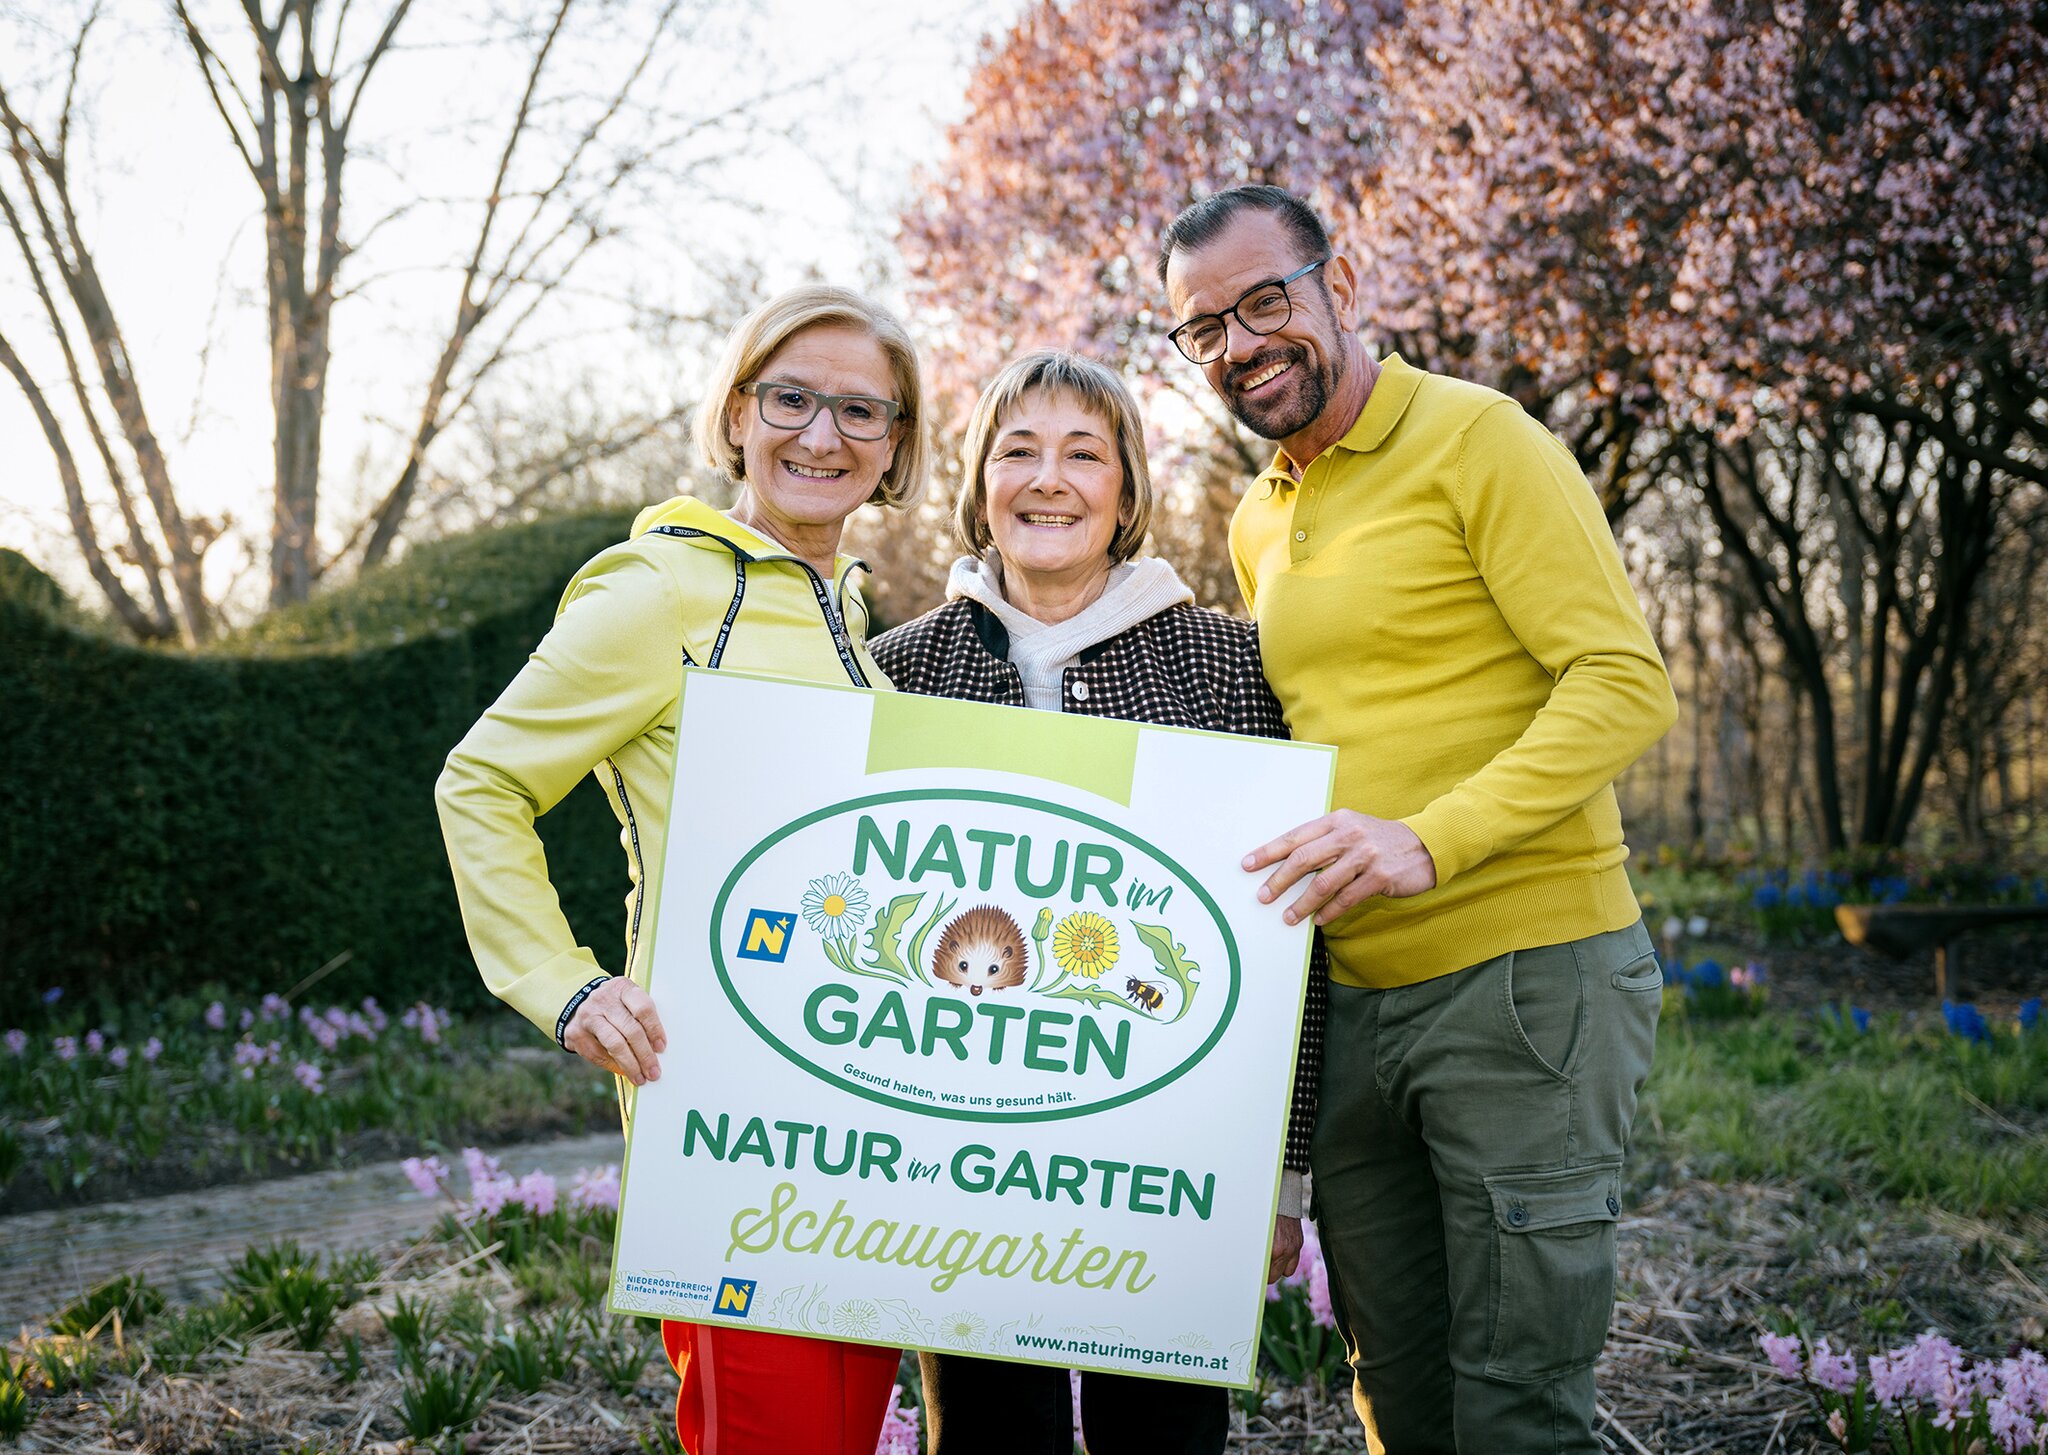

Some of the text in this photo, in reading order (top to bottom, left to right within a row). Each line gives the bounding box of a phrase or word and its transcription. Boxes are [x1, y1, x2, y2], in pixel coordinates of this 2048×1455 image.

[852, 815, 1174, 915] NATUR im
[803, 983, 1131, 1080] GARTEN
[843, 1063, 1077, 1108] Gesund halten, was uns gesund hält.
[682, 1108, 1216, 1221] NATUR im GARTEN
[725, 1182, 1157, 1294] Schaugarten
[625, 1283, 712, 1302] Einfach erfrischend.
[626, 1275, 713, 1293] NIEDERÖSTERREICH
[1015, 1333, 1230, 1371] www.naturimgarten.at
